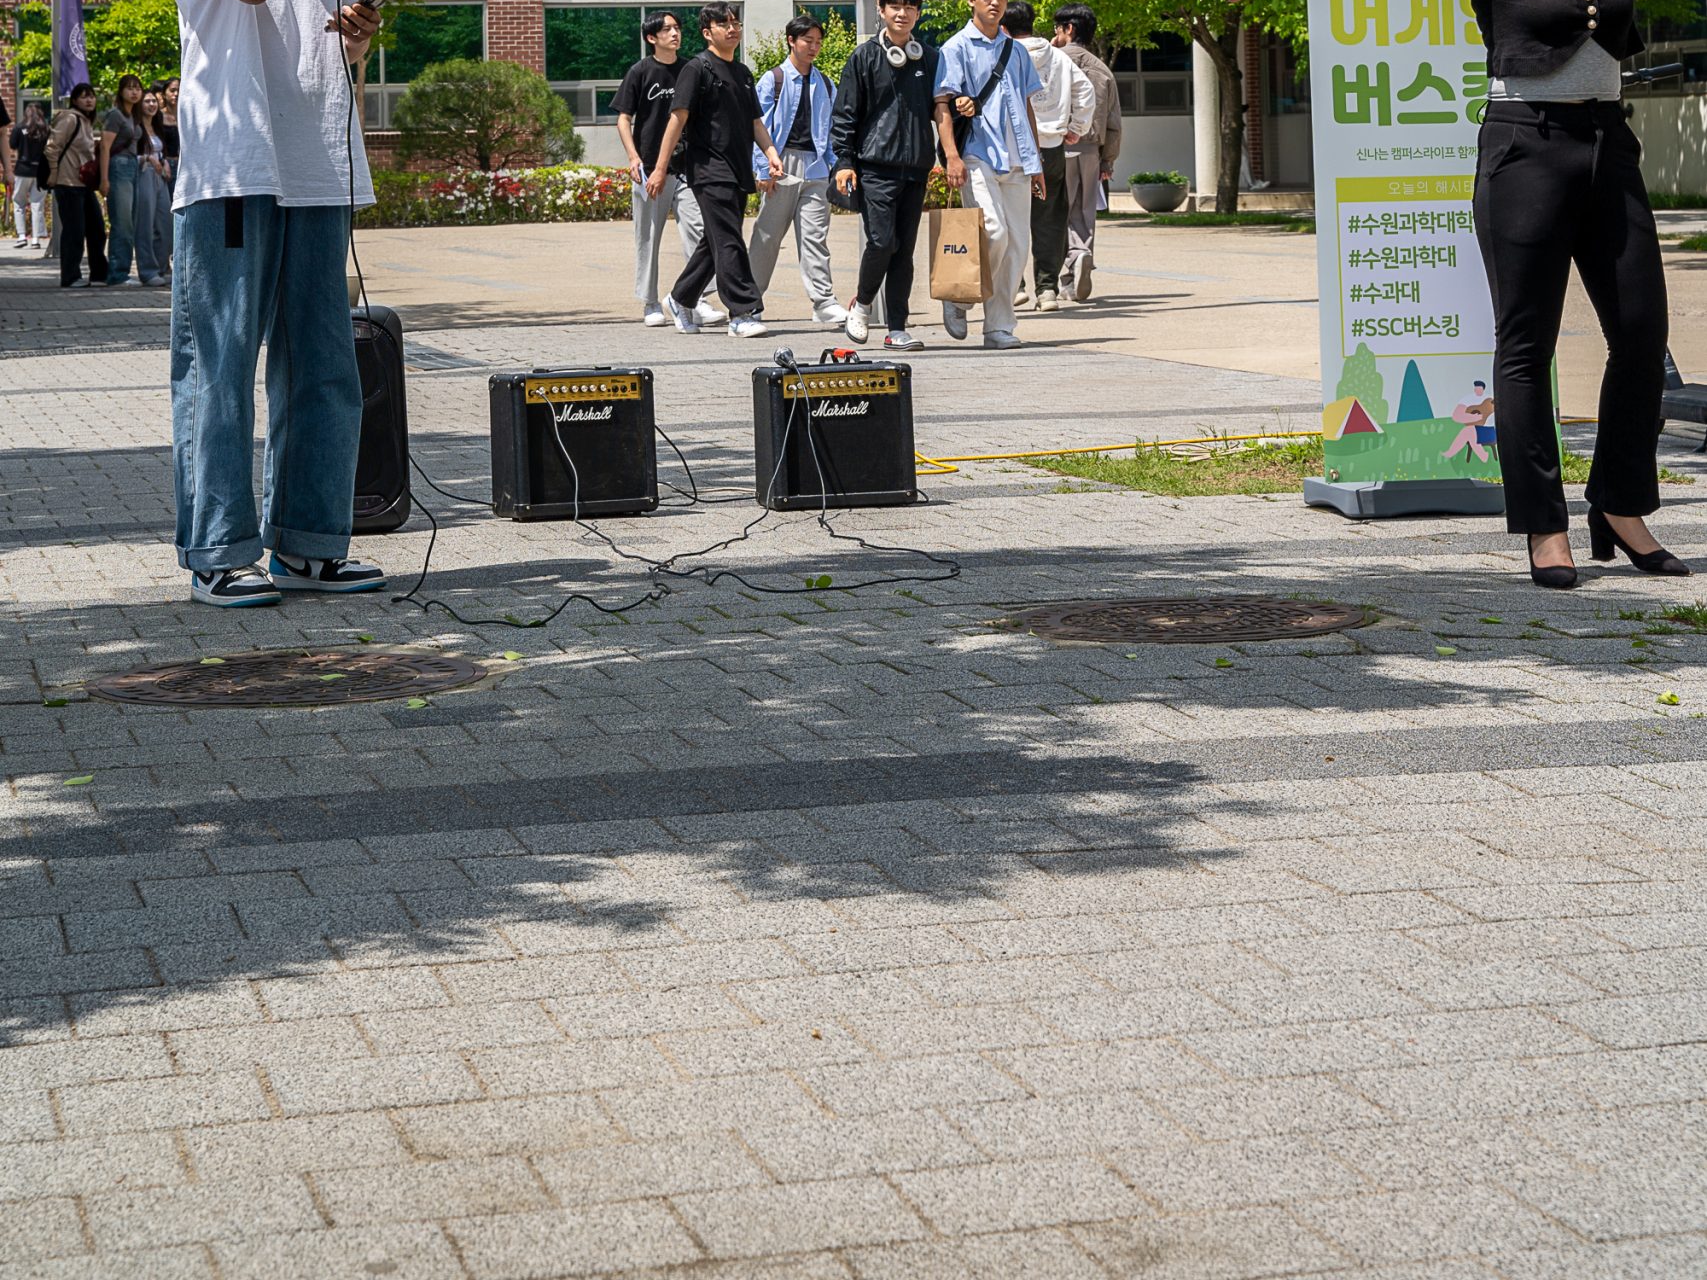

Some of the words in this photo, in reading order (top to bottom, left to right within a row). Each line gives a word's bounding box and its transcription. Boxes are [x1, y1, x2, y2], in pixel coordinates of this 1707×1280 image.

[647, 82, 676, 101] Cove
[1356, 148, 1389, 161] 신나는
[1391, 146, 1456, 161] 캠퍼스라이프
[1388, 180, 1429, 195] 오늘의
[1435, 180, 1475, 194] 해시태
[1348, 210, 1474, 236] #수원과학대학
[943, 244, 968, 255] FILA
[1348, 245, 1457, 270] #수원과학대
[1350, 280, 1421, 305] #수과대
[1351, 314, 1460, 338] #SSC버스킹
[555, 404, 614, 422] Marshall
[811, 400, 870, 417] Marshall
